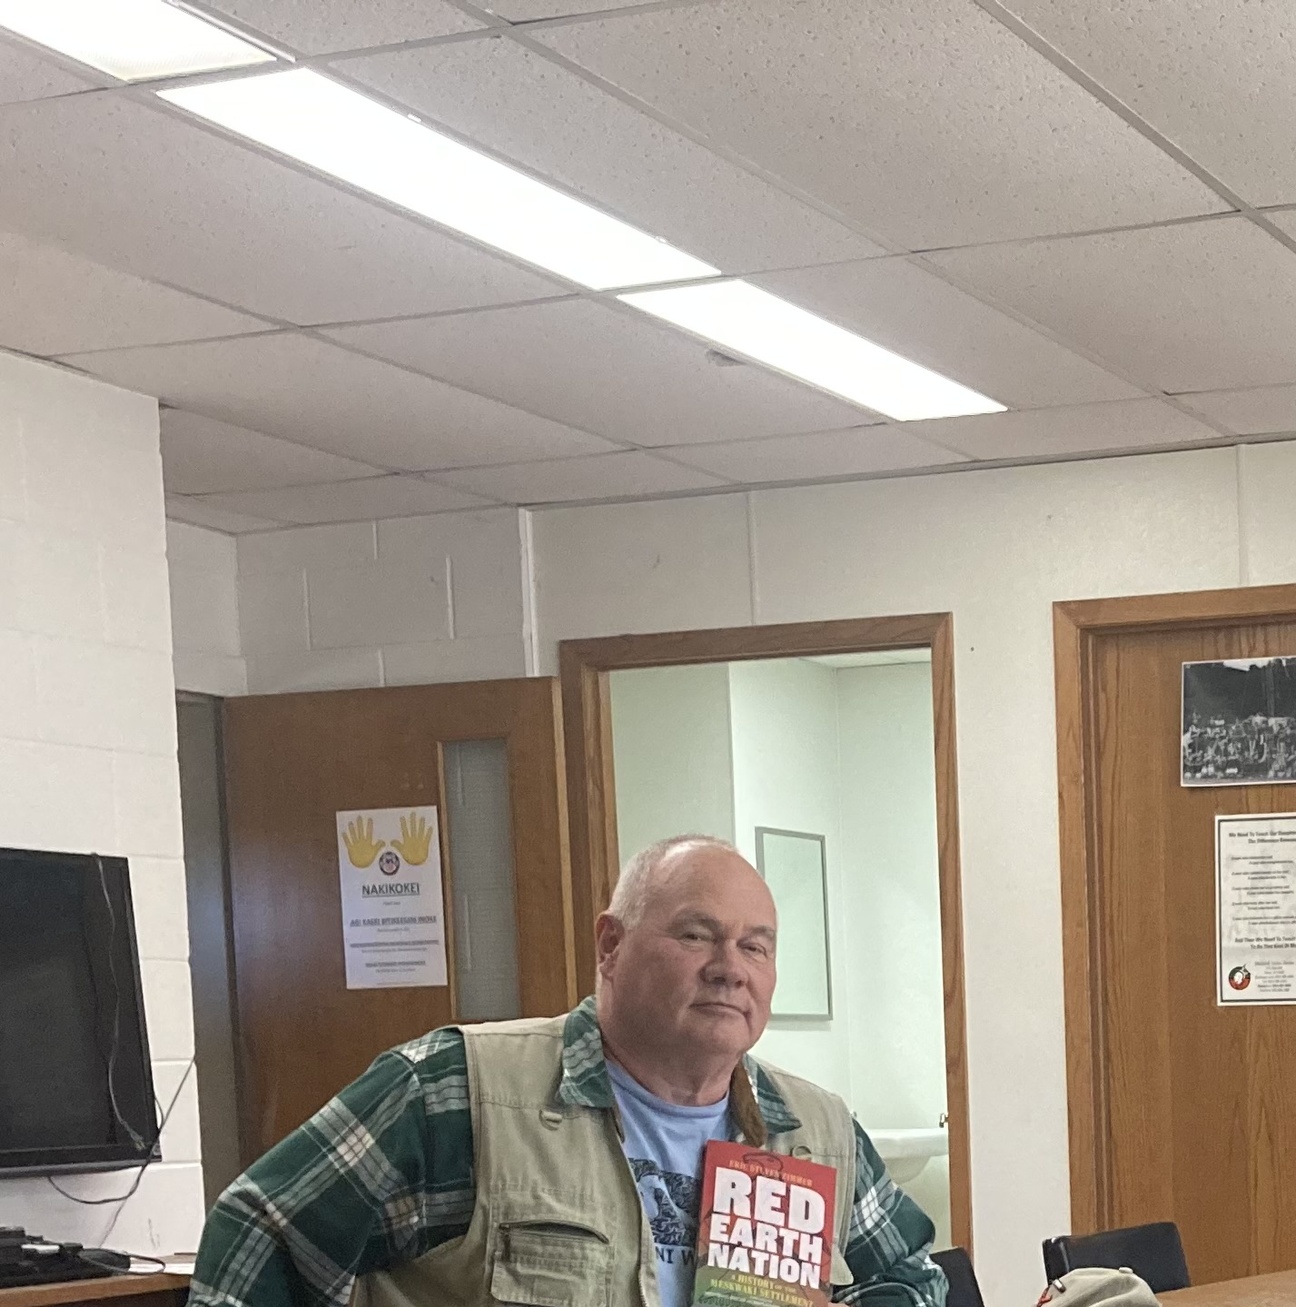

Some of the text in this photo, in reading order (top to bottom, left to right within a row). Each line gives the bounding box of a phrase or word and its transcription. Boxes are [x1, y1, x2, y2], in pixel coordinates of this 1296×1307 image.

[362, 882, 420, 896] NAKIKOKEI
[713, 1167, 825, 1234] RED
[709, 1213, 823, 1264] EARTH
[707, 1242, 821, 1290] NATION
[737, 1274, 774, 1290] HISTORY
[710, 1279, 757, 1296] MESKWAKI
